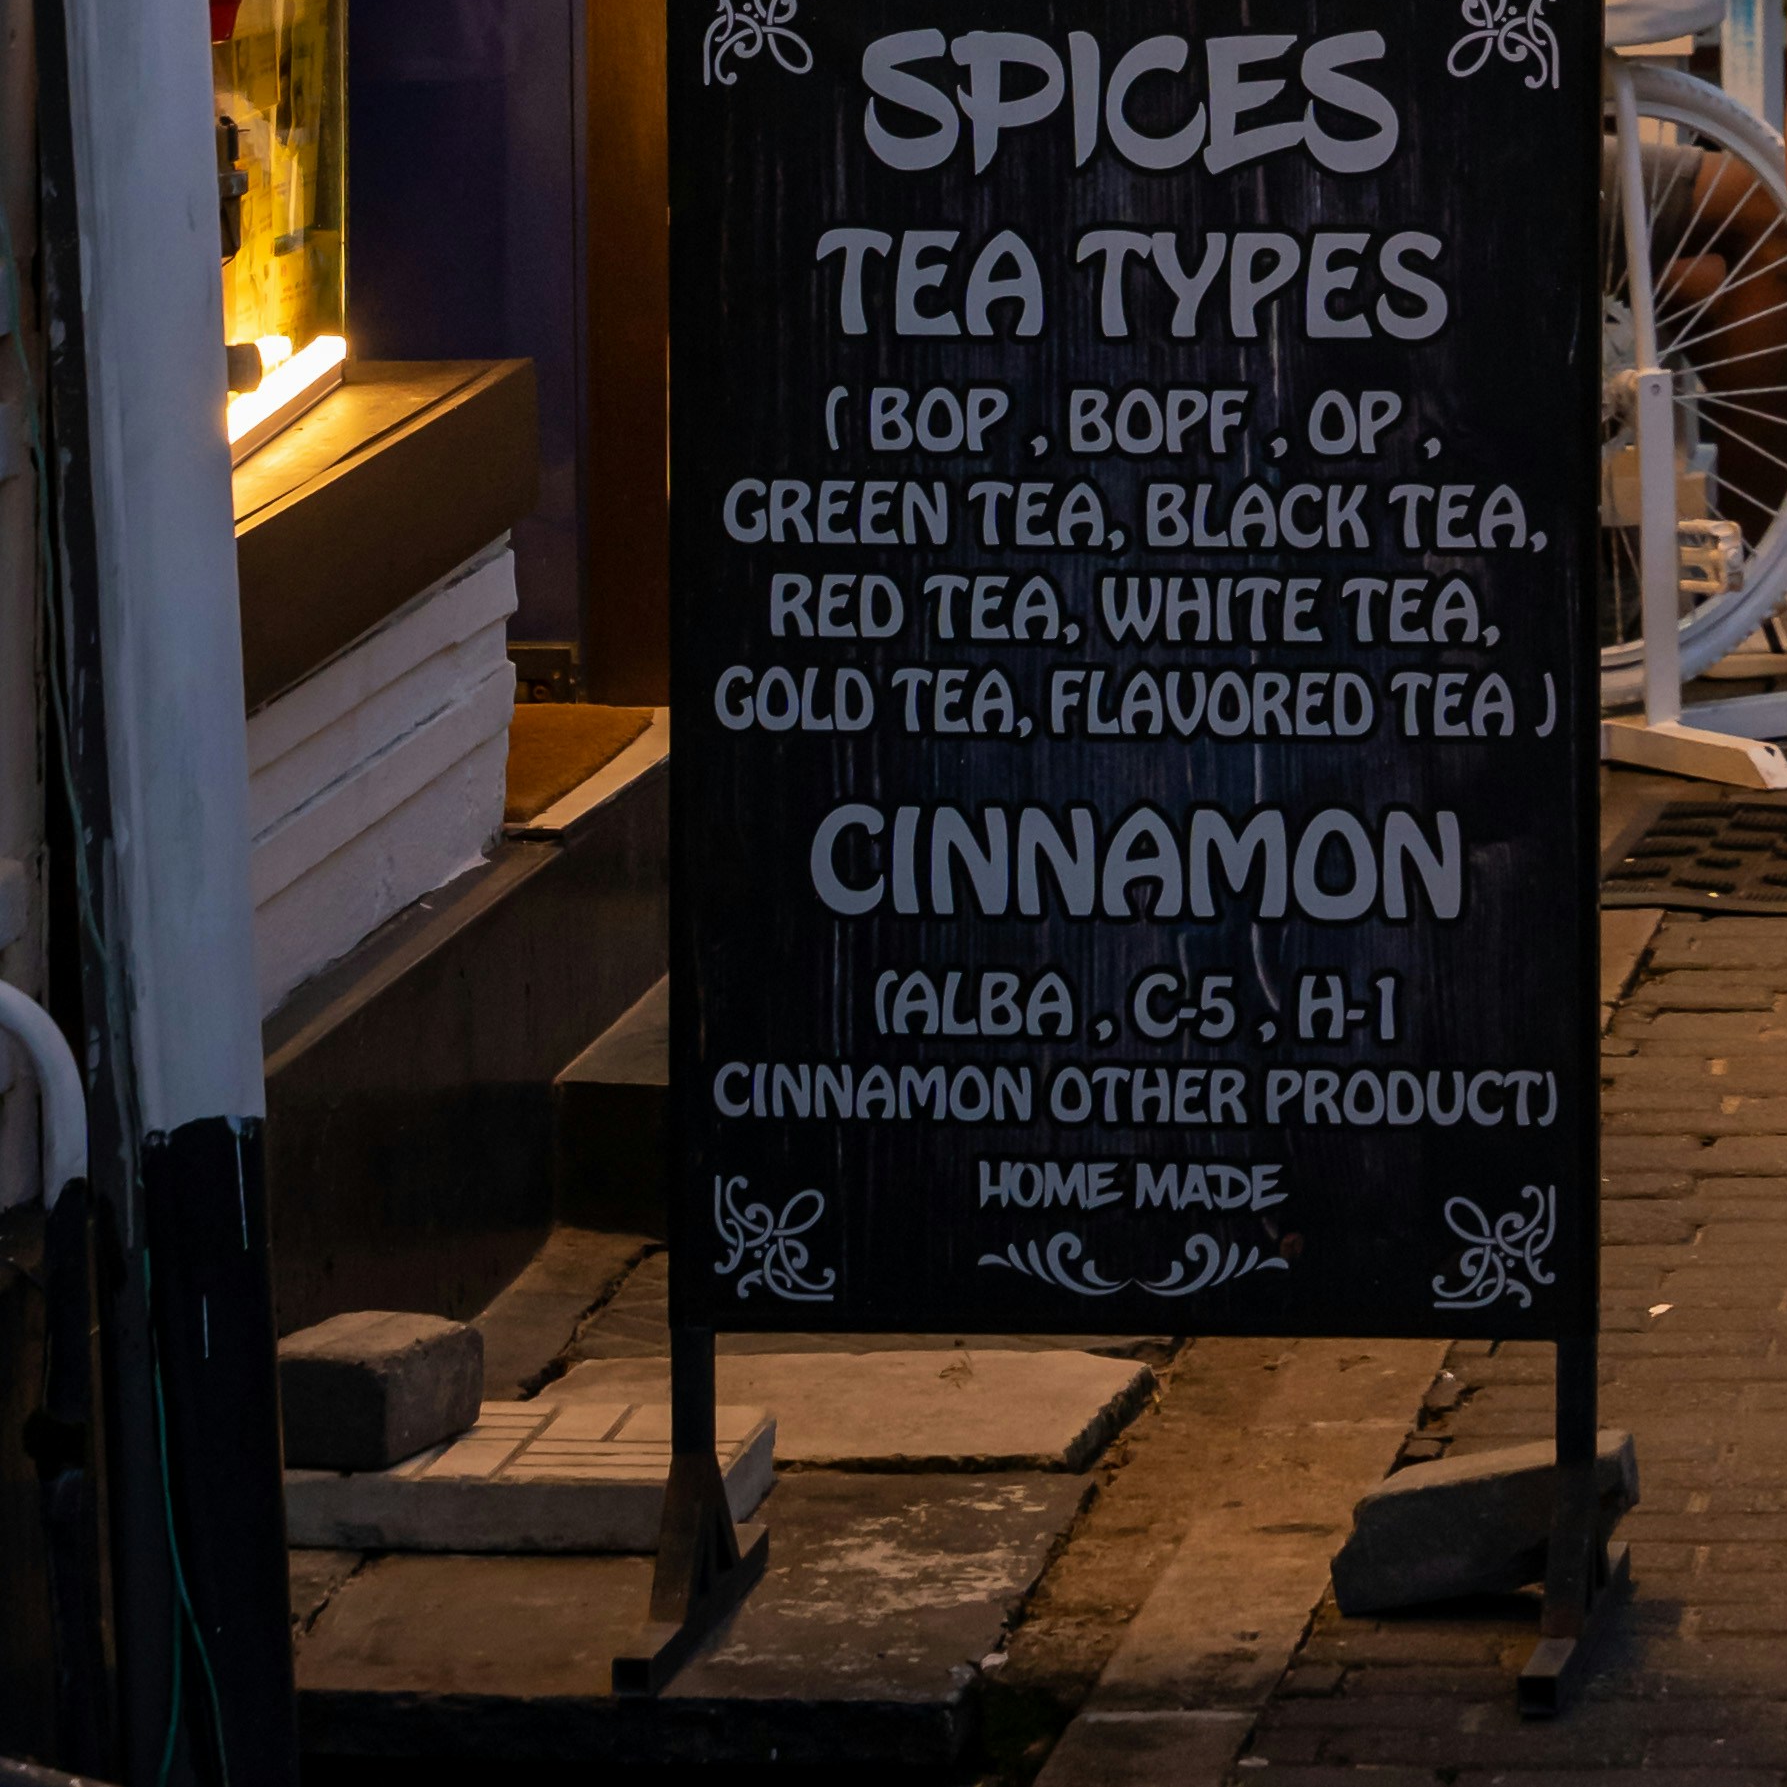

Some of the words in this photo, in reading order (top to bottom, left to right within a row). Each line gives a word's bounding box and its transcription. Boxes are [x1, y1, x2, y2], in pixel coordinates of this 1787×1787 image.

[861, 28, 1400, 175] SPICES
[816, 228, 1044, 336] TEA
[1076, 229, 1448, 340] TYPES
[723, 478, 949, 545] GREEN
[968, 481, 1125, 551] TEA,
[1146, 483, 1369, 548] BLACK
[1388, 484, 1548, 552] TEA,
[770, 573, 904, 637] RED
[923, 574, 1080, 644] TEA,
[1101, 577, 1323, 642] WHITE
[1341, 577, 1500, 646] TEA,
[714, 665, 874, 731] GOLD
[891, 668, 1032, 737] TEA,
[1051, 670, 1373, 736] FLAVORED
[810, 803, 1462, 920] CINNAMON
[1298, 976, 1401, 1040] H-1
[714, 1063, 1031, 1121] CINNAMON
[1050, 1067, 1248, 1123] OTHER
[1266, 1069, 1557, 1126] PRODUCT)
[979, 1161, 1126, 1209] HOME
[1135, 1163, 1289, 1212] MADE
